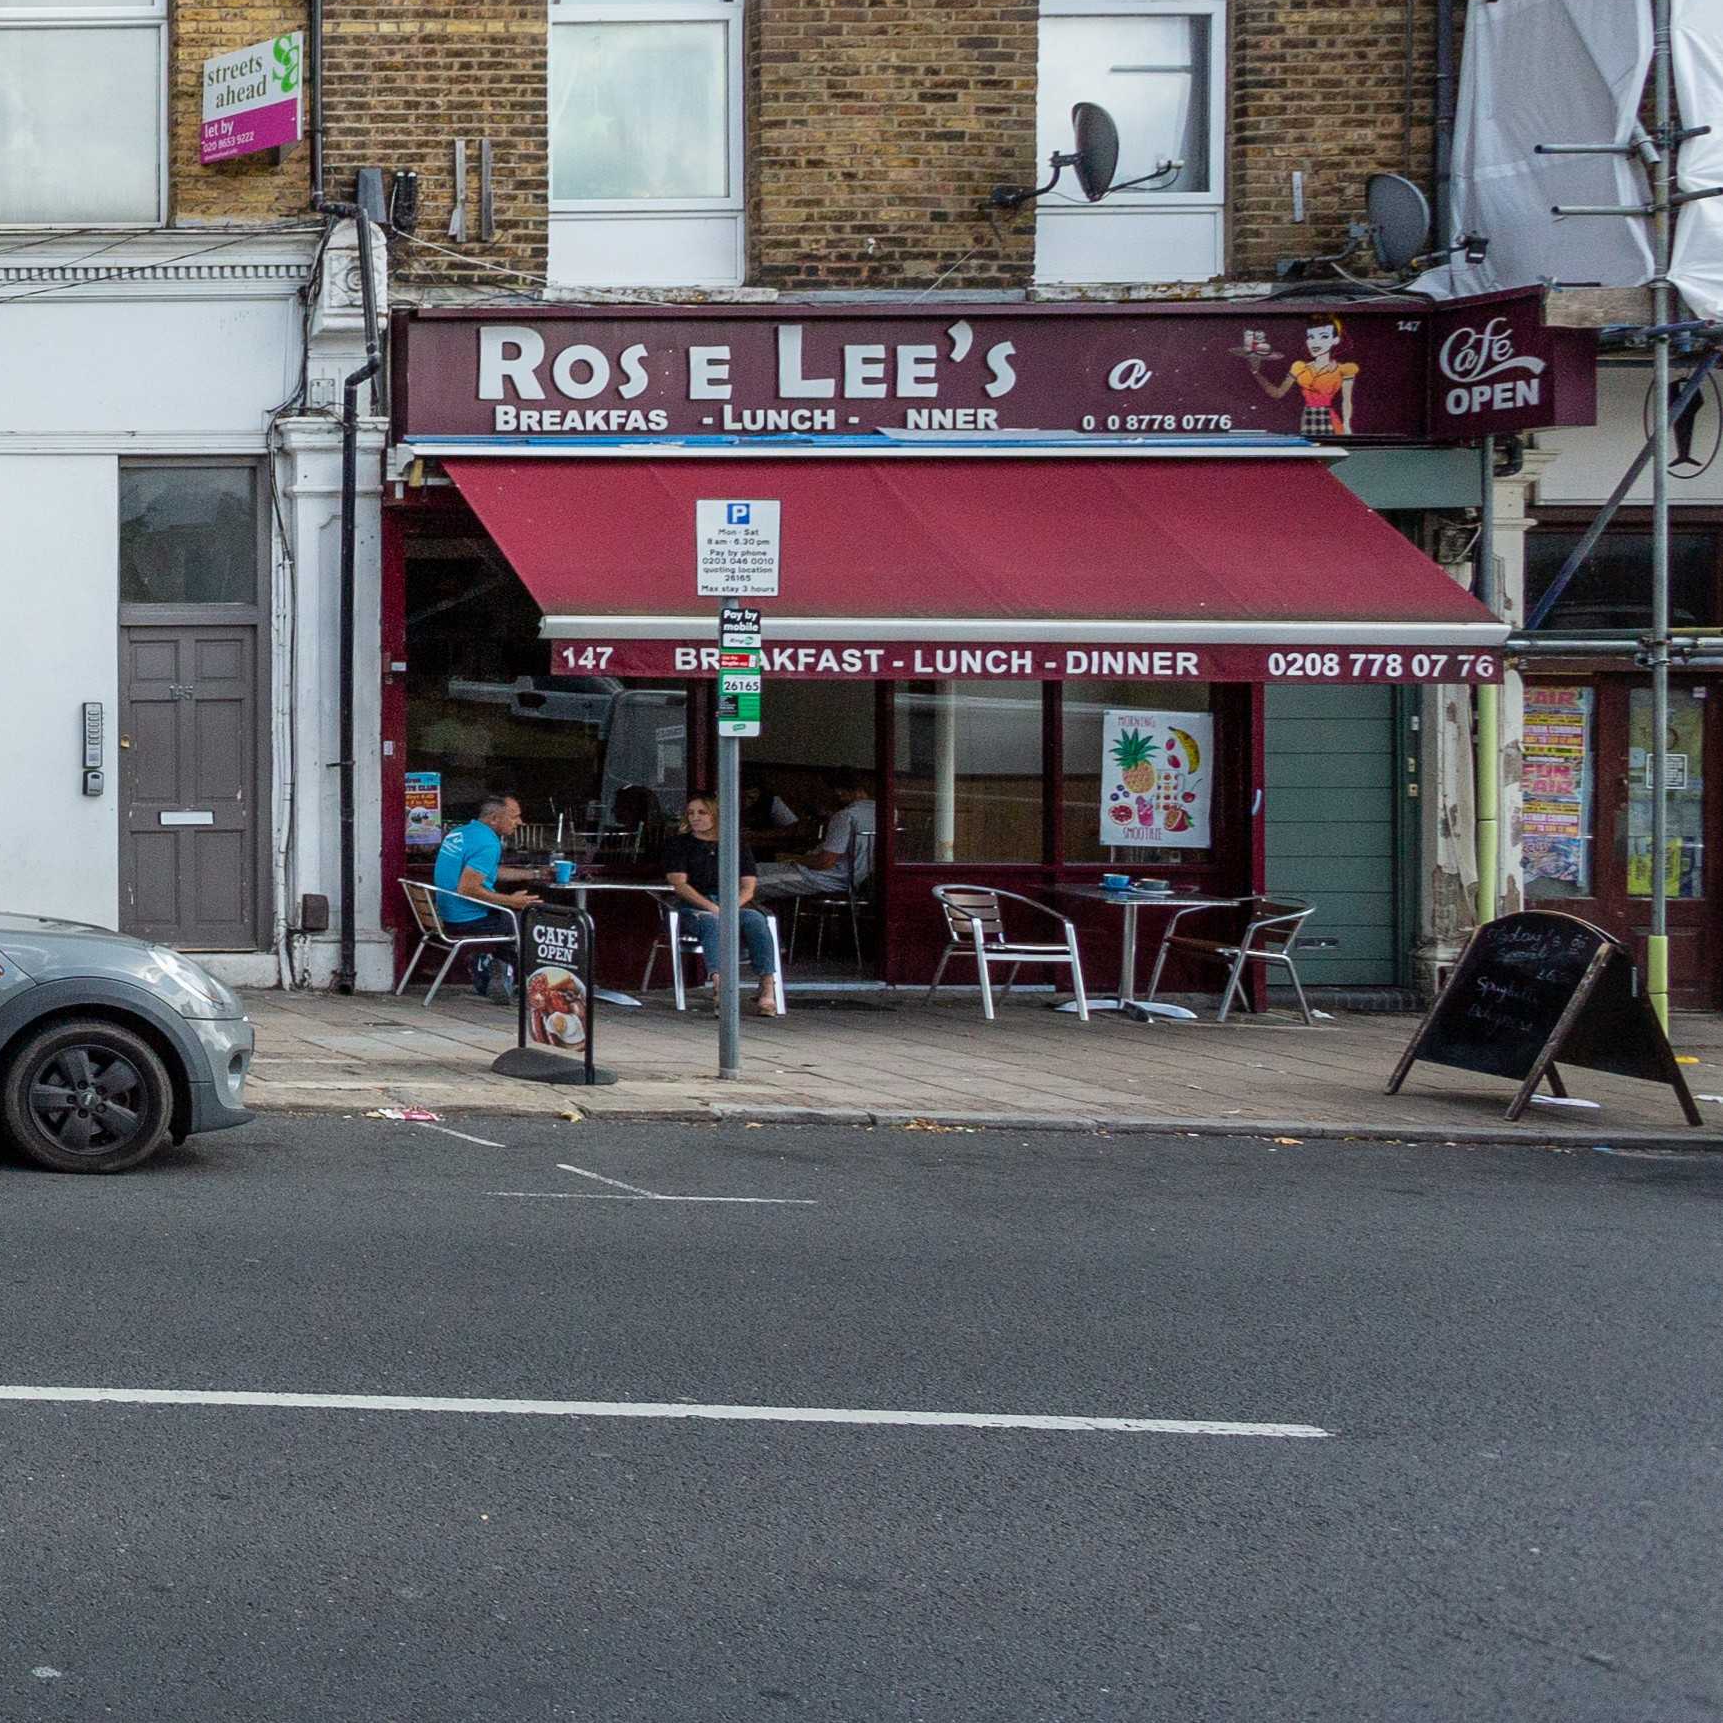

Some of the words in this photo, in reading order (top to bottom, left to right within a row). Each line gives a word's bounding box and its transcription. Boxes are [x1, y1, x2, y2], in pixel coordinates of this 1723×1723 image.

[207, 56, 263, 87] streets
[216, 75, 267, 109] ahead
[204, 122, 218, 139] let
[220, 119, 234, 137] by
[1446, 378, 1540, 415] OPEN
[723, 404, 836, 431] LUNCH
[1126, 414, 1176, 430] 8778
[1182, 414, 1233, 430] 0776
[744, 528, 759, 536] Sat
[710, 549, 725, 557] Pay
[728, 549, 738, 557] by
[740, 549, 767, 557] phone
[702, 557, 727, 565] 0203
[703, 566, 736, 574] quoting
[724, 574, 752, 582] 26165
[701, 584, 718, 592] Max
[722, 585, 739, 593] stay
[751, 585, 775, 593] hours
[724, 608, 744, 622] Pay
[745, 608, 758, 622] by
[723, 622, 759, 632] mobile
[561, 646, 614, 670] 147
[914, 648, 1032, 674] LUNCH
[1065, 651, 1199, 675] DINNER
[1267, 652, 1340, 677] 0208
[1349, 653, 1402, 677] 778
[724, 680, 760, 691] 26165
[1118, 716, 1155, 727] MORNING
[533, 924, 578, 949] CAFÉ
[537, 944, 573, 963] OPEN
